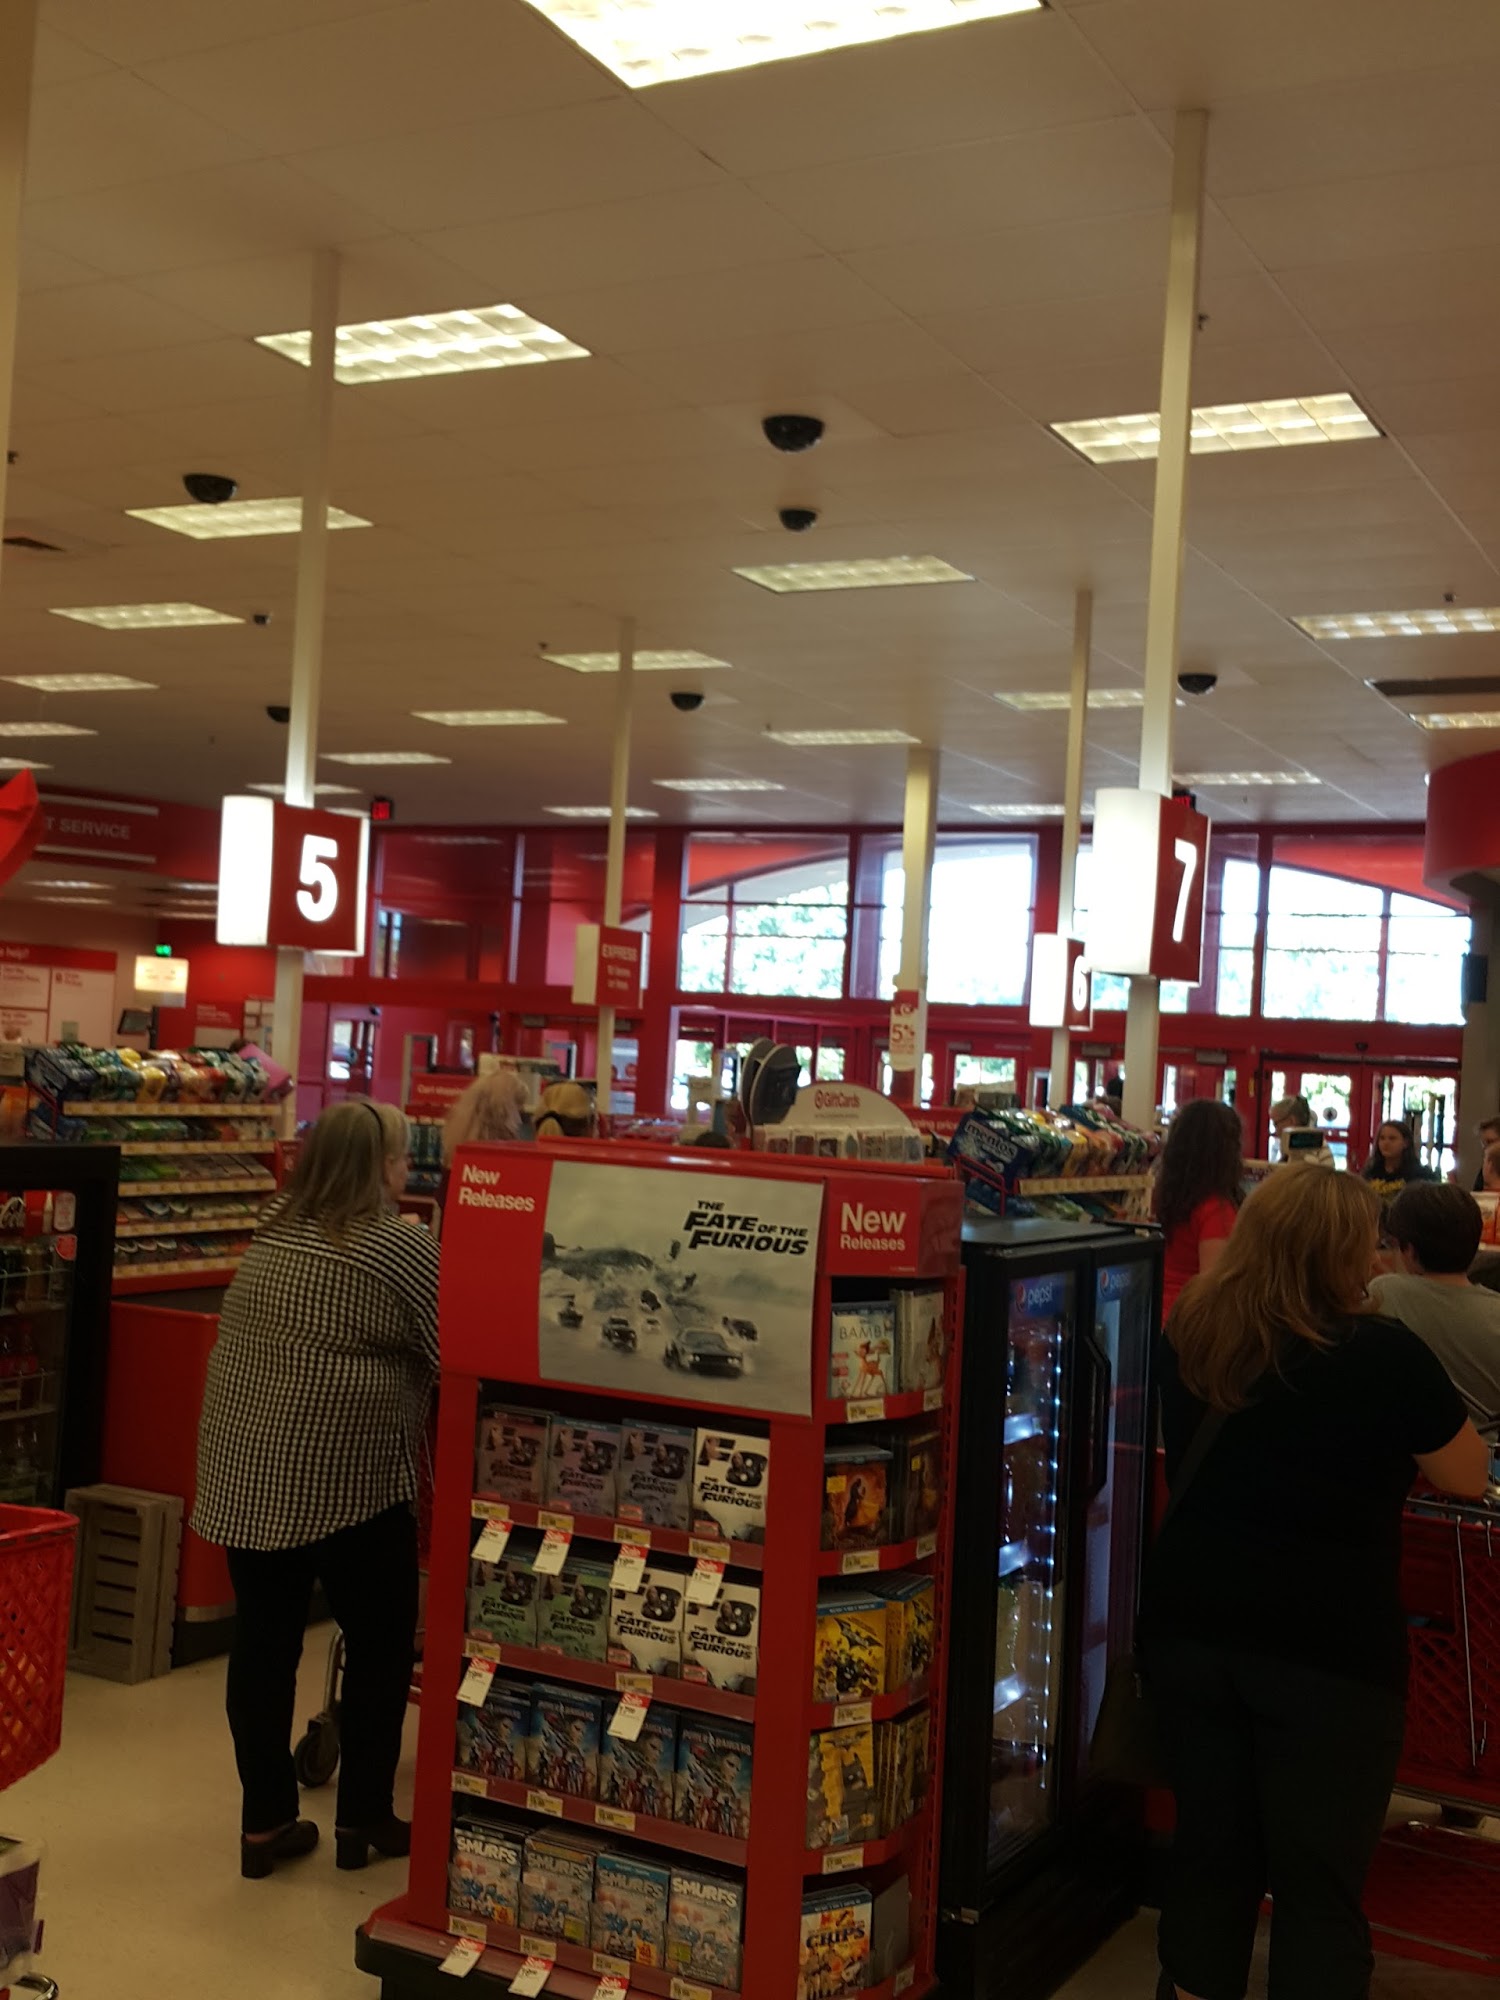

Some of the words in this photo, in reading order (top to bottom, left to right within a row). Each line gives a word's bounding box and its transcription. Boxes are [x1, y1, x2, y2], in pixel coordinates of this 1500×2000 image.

[59, 817, 131, 840] SERVICE
[296, 833, 338, 922] 5
[1173, 837, 1197, 943] 7
[1072, 955, 1089, 1011] 6
[966, 1121, 1016, 1158] mentos
[462, 1163, 500, 1185] New
[458, 1187, 535, 1212] Releases
[684, 1211, 758, 1232] FATE
[758, 1223, 778, 1234] OF
[780, 1226, 808, 1237] THE
[841, 1202, 906, 1234] New
[688, 1230, 809, 1255] FURIOUS
[840, 1234, 905, 1251] Releases
[701, 1492, 763, 1510] FURIOUS
[617, 1626, 677, 1644] FURIOUS
[692, 1641, 753, 1659] FURIOUS
[456, 1835, 518, 1866] SMURFS
[527, 1852, 590, 1881] SMURFS
[599, 1869, 664, 1899] SMURFS
[671, 1877, 738, 1908] SMURFS
